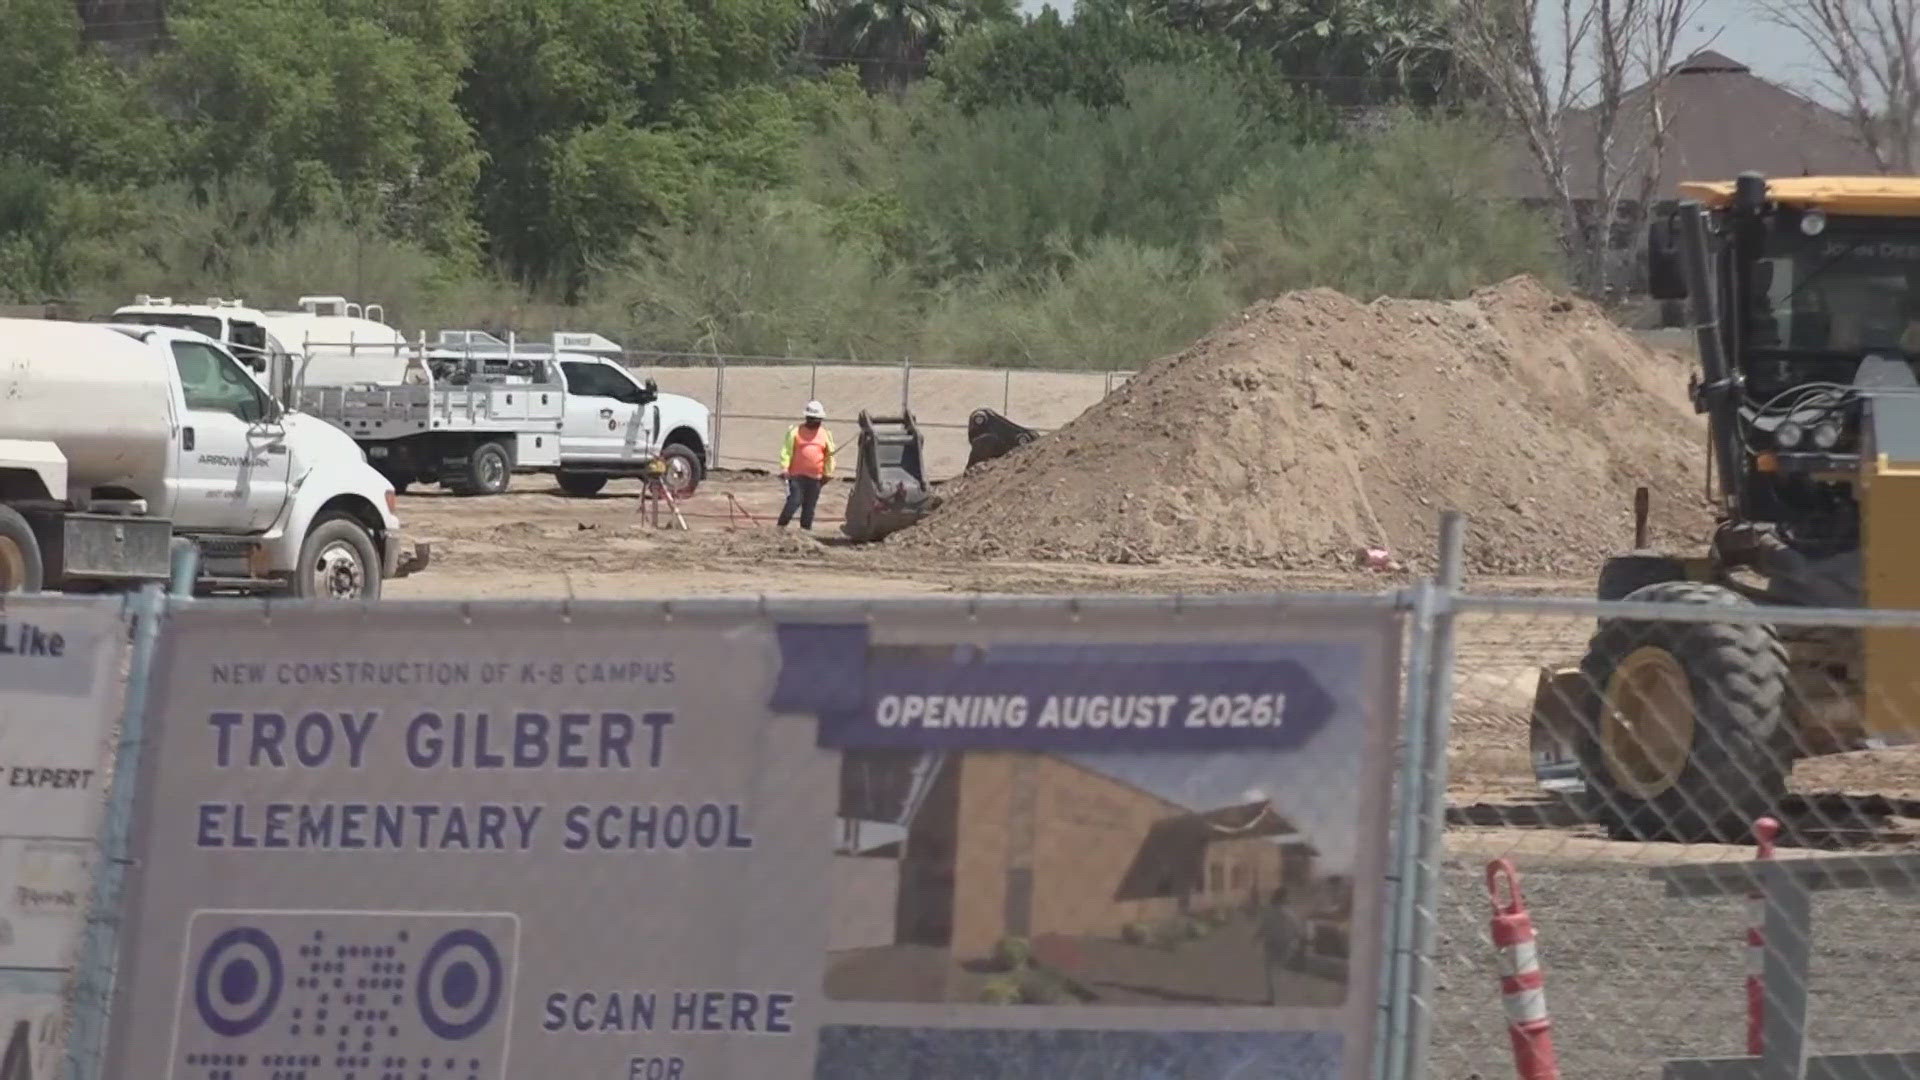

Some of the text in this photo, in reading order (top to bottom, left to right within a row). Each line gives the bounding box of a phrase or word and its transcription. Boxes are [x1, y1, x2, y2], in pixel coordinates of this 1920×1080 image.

[0, 622, 66, 656] Like
[211, 663, 264, 684] NEW
[277, 662, 469, 685] CONSTRUCTION
[481, 663, 508, 684] OF
[575, 661, 675, 684] CAMPUS
[876, 694, 1285, 728] OPENING AUGUST 2026!
[209, 711, 674, 769] TROY GILBERT
[10, 767, 95, 789] EXPERT
[198, 804, 752, 849] ELEMENTARY SCHOOL
[543, 992, 794, 1032] SCAN HERE
[629, 1057, 684, 1080] FOR
